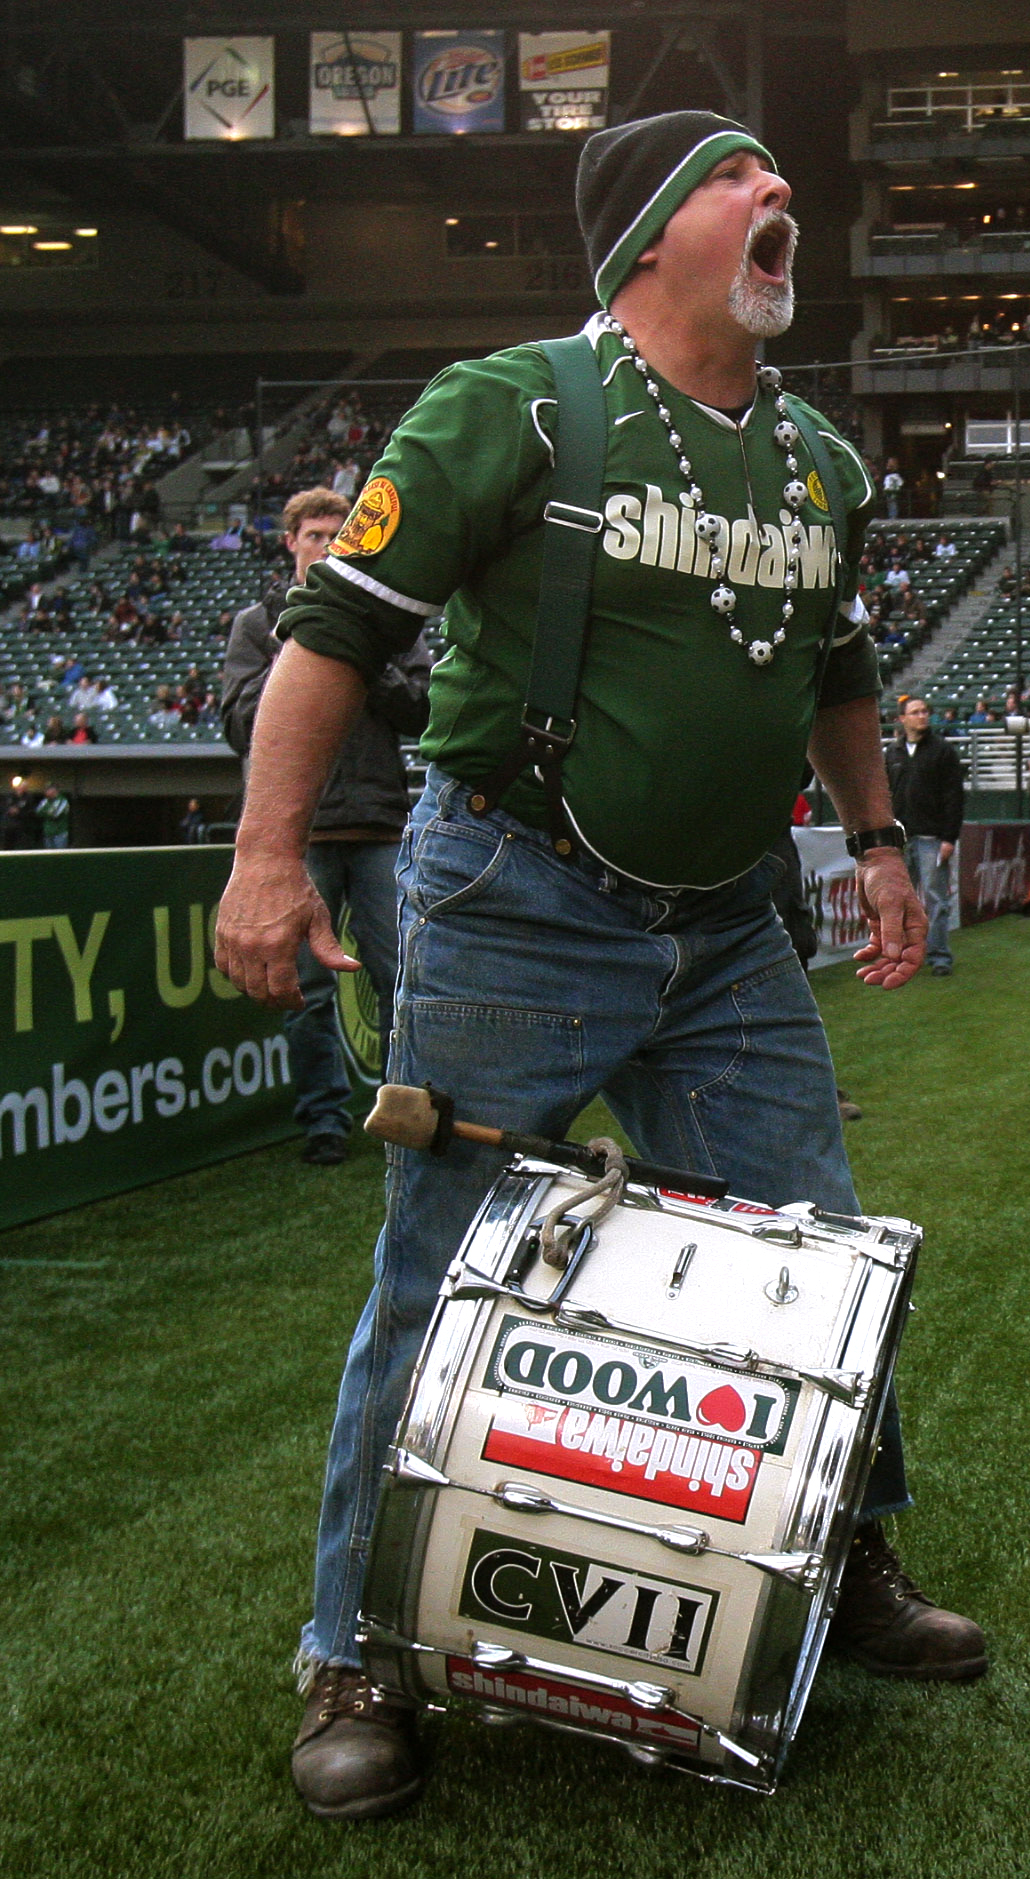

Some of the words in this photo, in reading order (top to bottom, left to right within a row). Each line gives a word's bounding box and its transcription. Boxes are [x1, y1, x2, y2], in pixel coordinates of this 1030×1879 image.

[207, 80, 250, 97] PGE
[532, 91, 601, 105] YOUR
[527, 117, 605, 131] STORE
[603, 484, 836, 589] shindaiw
[503, 1341, 691, 1422] WOOD
[746, 1394, 777, 1439] I
[560, 1406, 755, 1497] shindaiwa
[472, 1549, 704, 1661] CVII
[451, 1671, 631, 1731] shindaiwa
